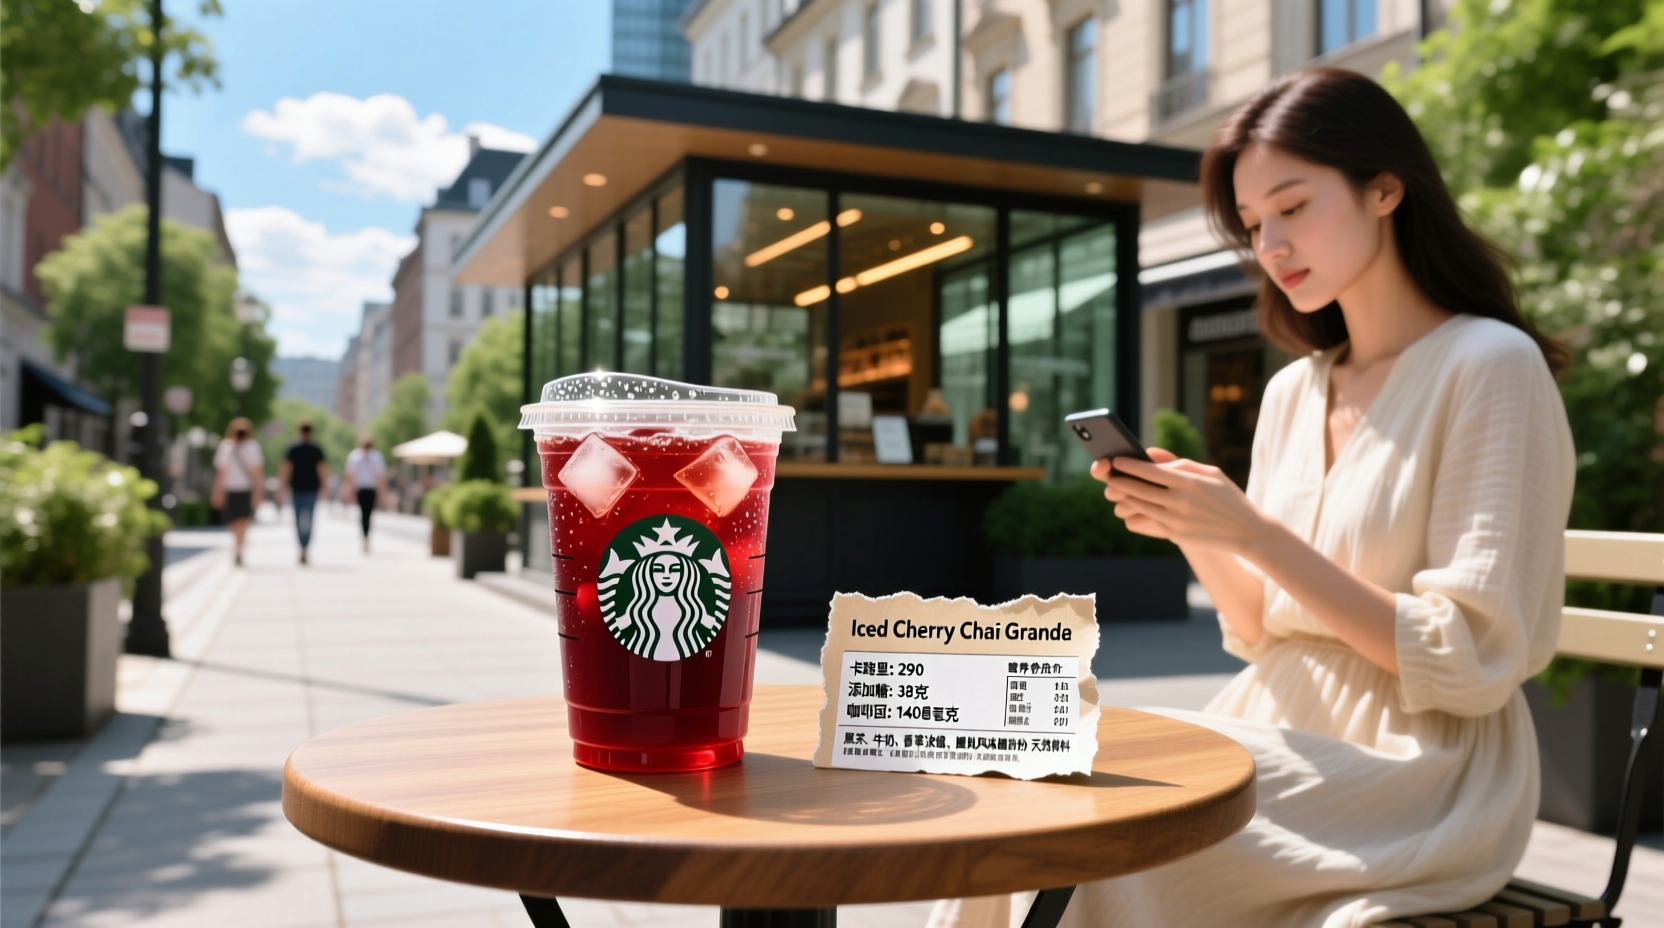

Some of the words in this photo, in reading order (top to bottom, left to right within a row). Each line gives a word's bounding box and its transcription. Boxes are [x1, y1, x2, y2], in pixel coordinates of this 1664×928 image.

[851, 619, 888, 638] Iced
[893, 620, 955, 645] Cherry
[960, 620, 1001, 641] Chai
[1005, 622, 1072, 641] Grande
[898, 663, 924, 676] 290
[897, 684, 930, 700] 38克
